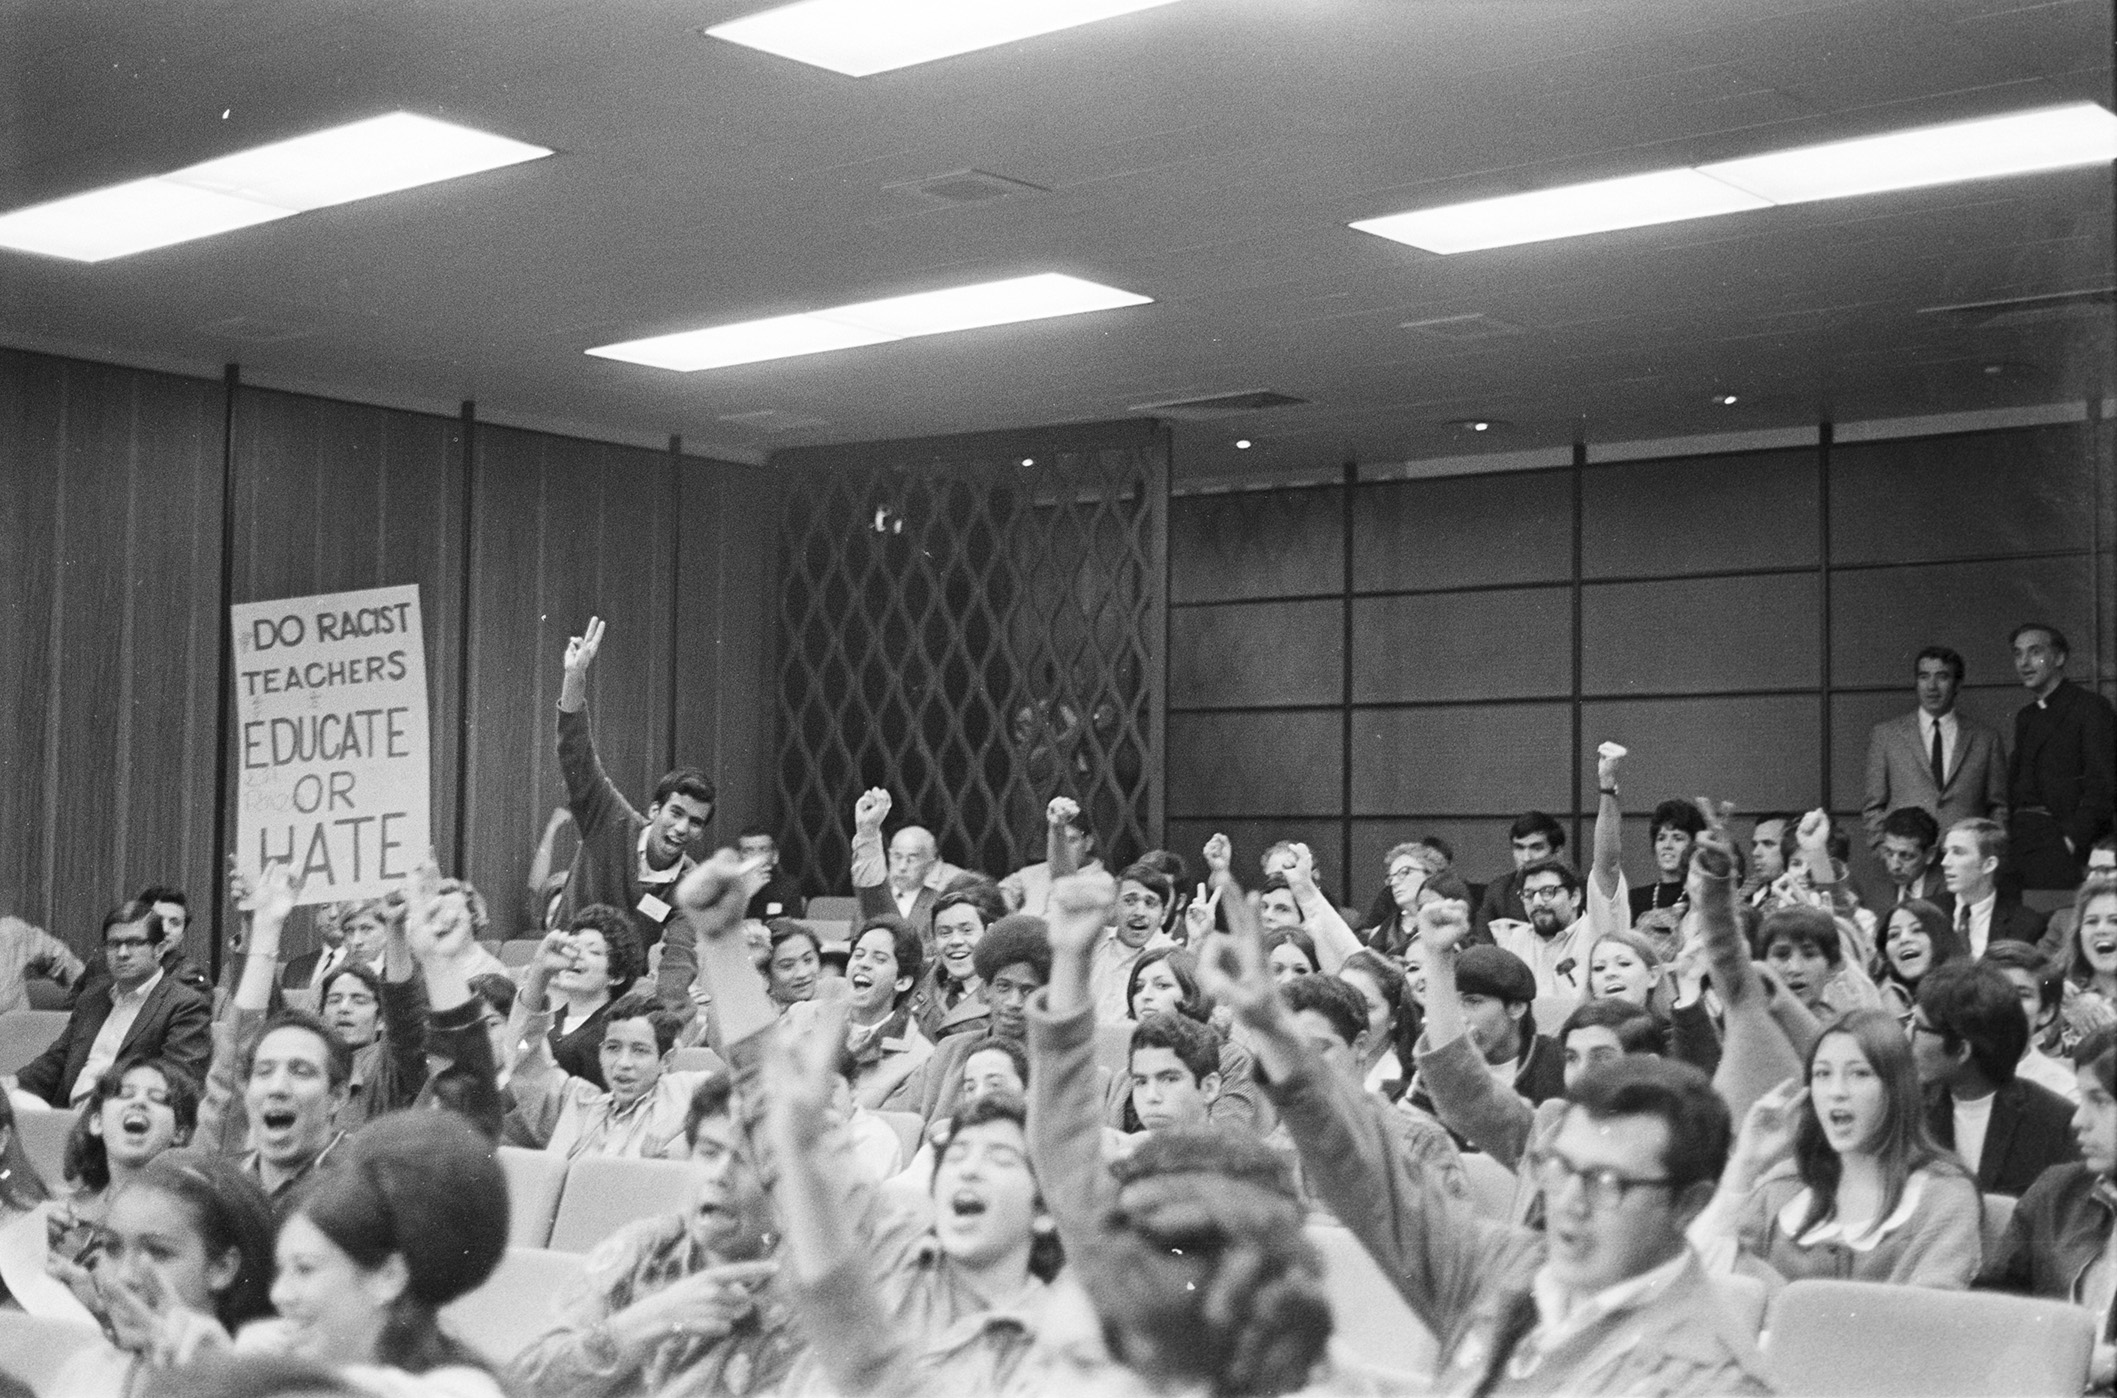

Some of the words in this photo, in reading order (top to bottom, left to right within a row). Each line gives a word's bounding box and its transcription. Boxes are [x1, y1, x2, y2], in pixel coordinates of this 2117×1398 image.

[253, 615, 305, 651] DO
[317, 602, 411, 642] RACIST
[241, 650, 407, 696] TEACHERS
[244, 707, 409, 769] EDUCATE
[293, 771, 356, 814] OR
[260, 812, 407, 888] HATE
